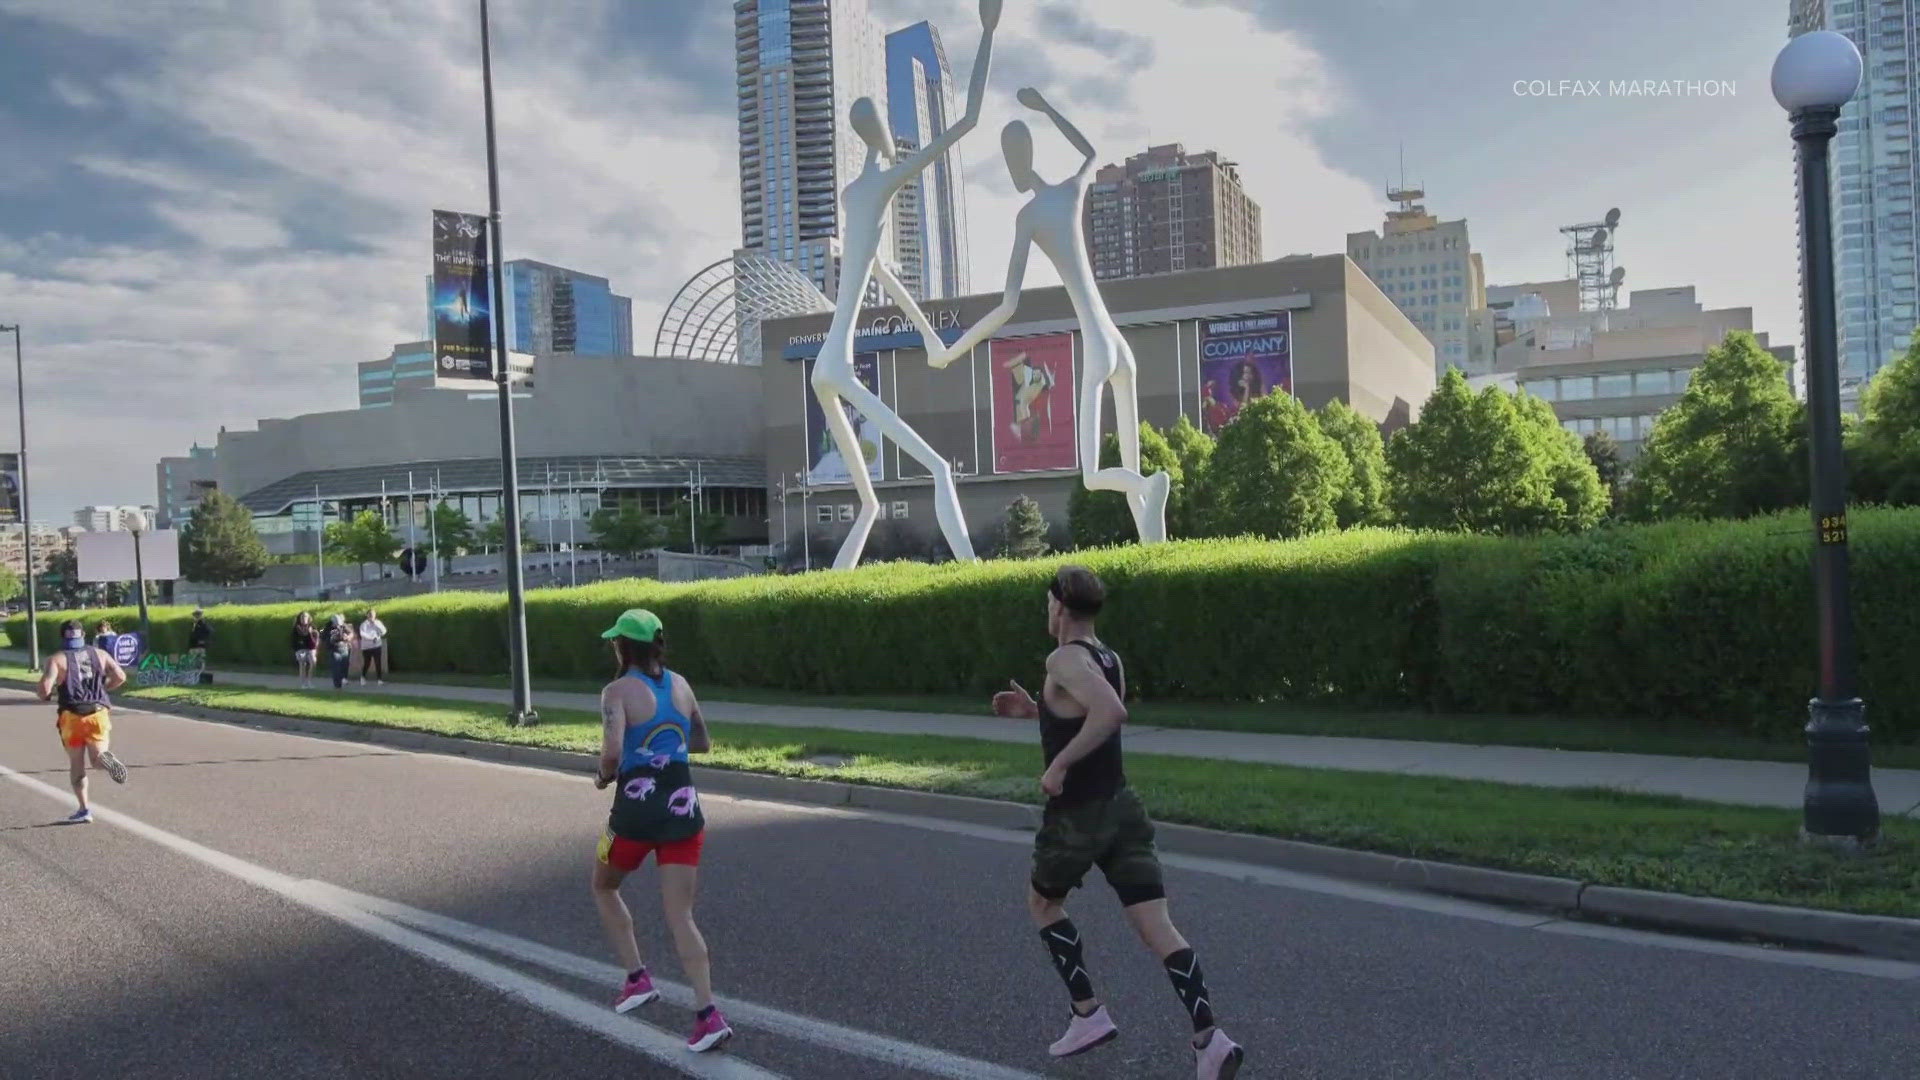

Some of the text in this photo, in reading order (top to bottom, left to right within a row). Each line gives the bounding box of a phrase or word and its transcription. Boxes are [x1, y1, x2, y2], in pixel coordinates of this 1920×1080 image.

[435, 253, 451, 263] THE
[789, 332, 822, 346] DENVER
[1204, 335, 1284, 357] COMPANY
[1821, 515, 1846, 529] 934
[1822, 530, 1845, 543] 521
